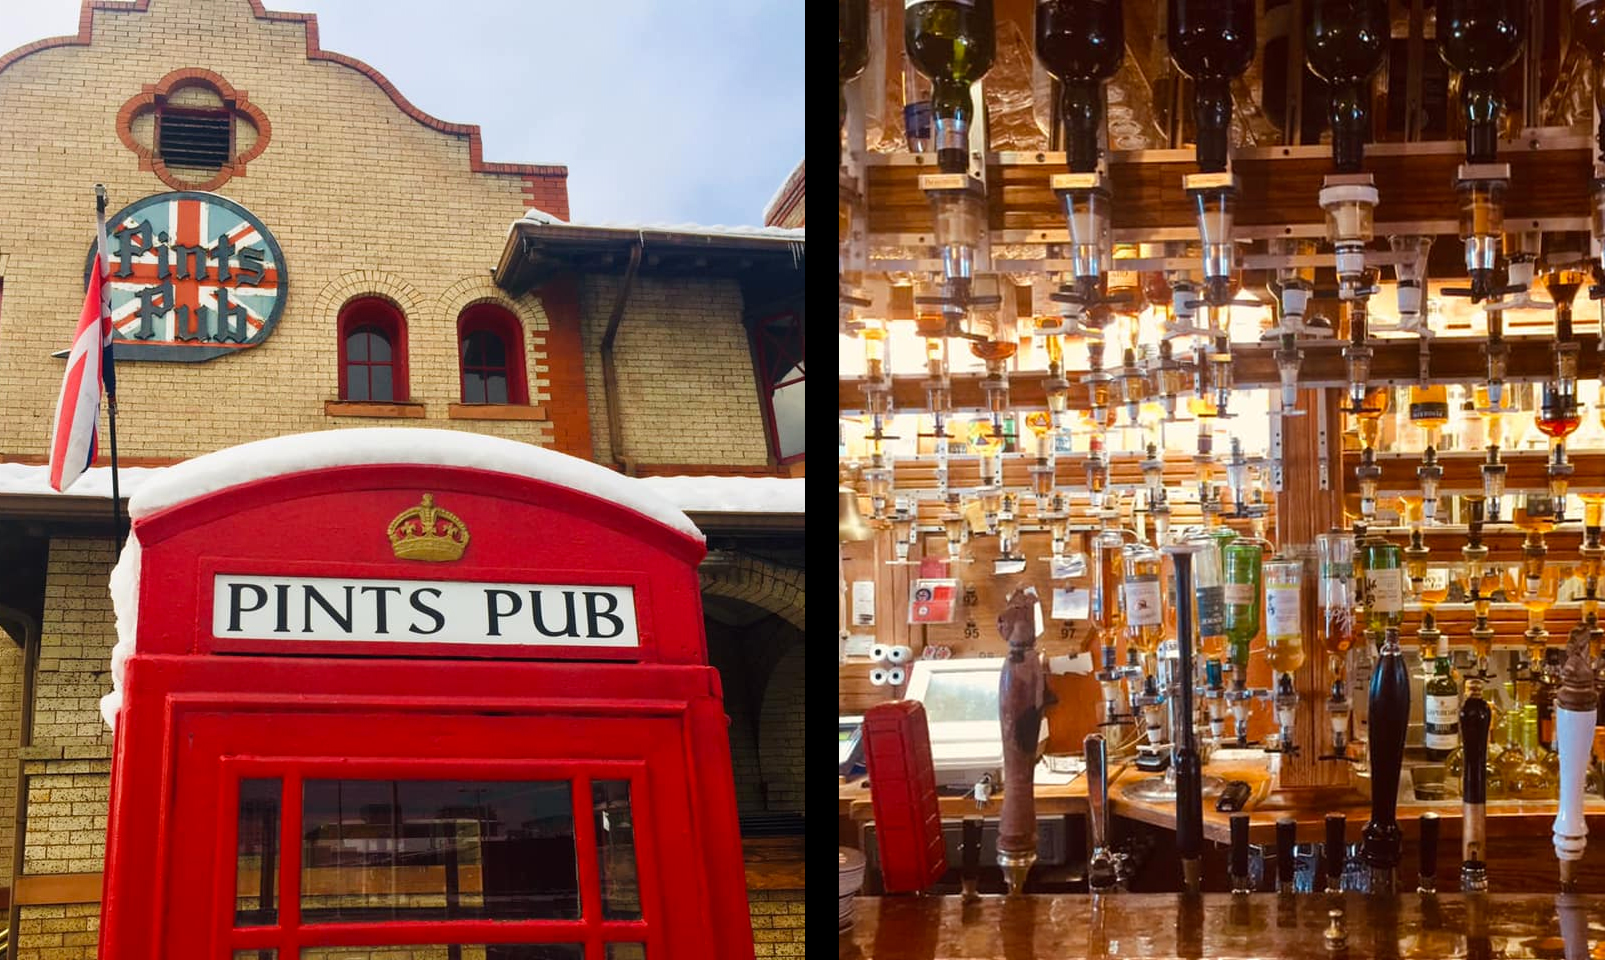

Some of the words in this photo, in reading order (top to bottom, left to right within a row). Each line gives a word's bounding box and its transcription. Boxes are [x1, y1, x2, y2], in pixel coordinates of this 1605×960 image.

[113, 219, 265, 287] Pints
[133, 281, 248, 343] Pub
[226, 583, 446, 634] PINTS
[483, 589, 625, 638] PUB
[964, 628, 980, 639] 95
[1061, 628, 1076, 639] 97
